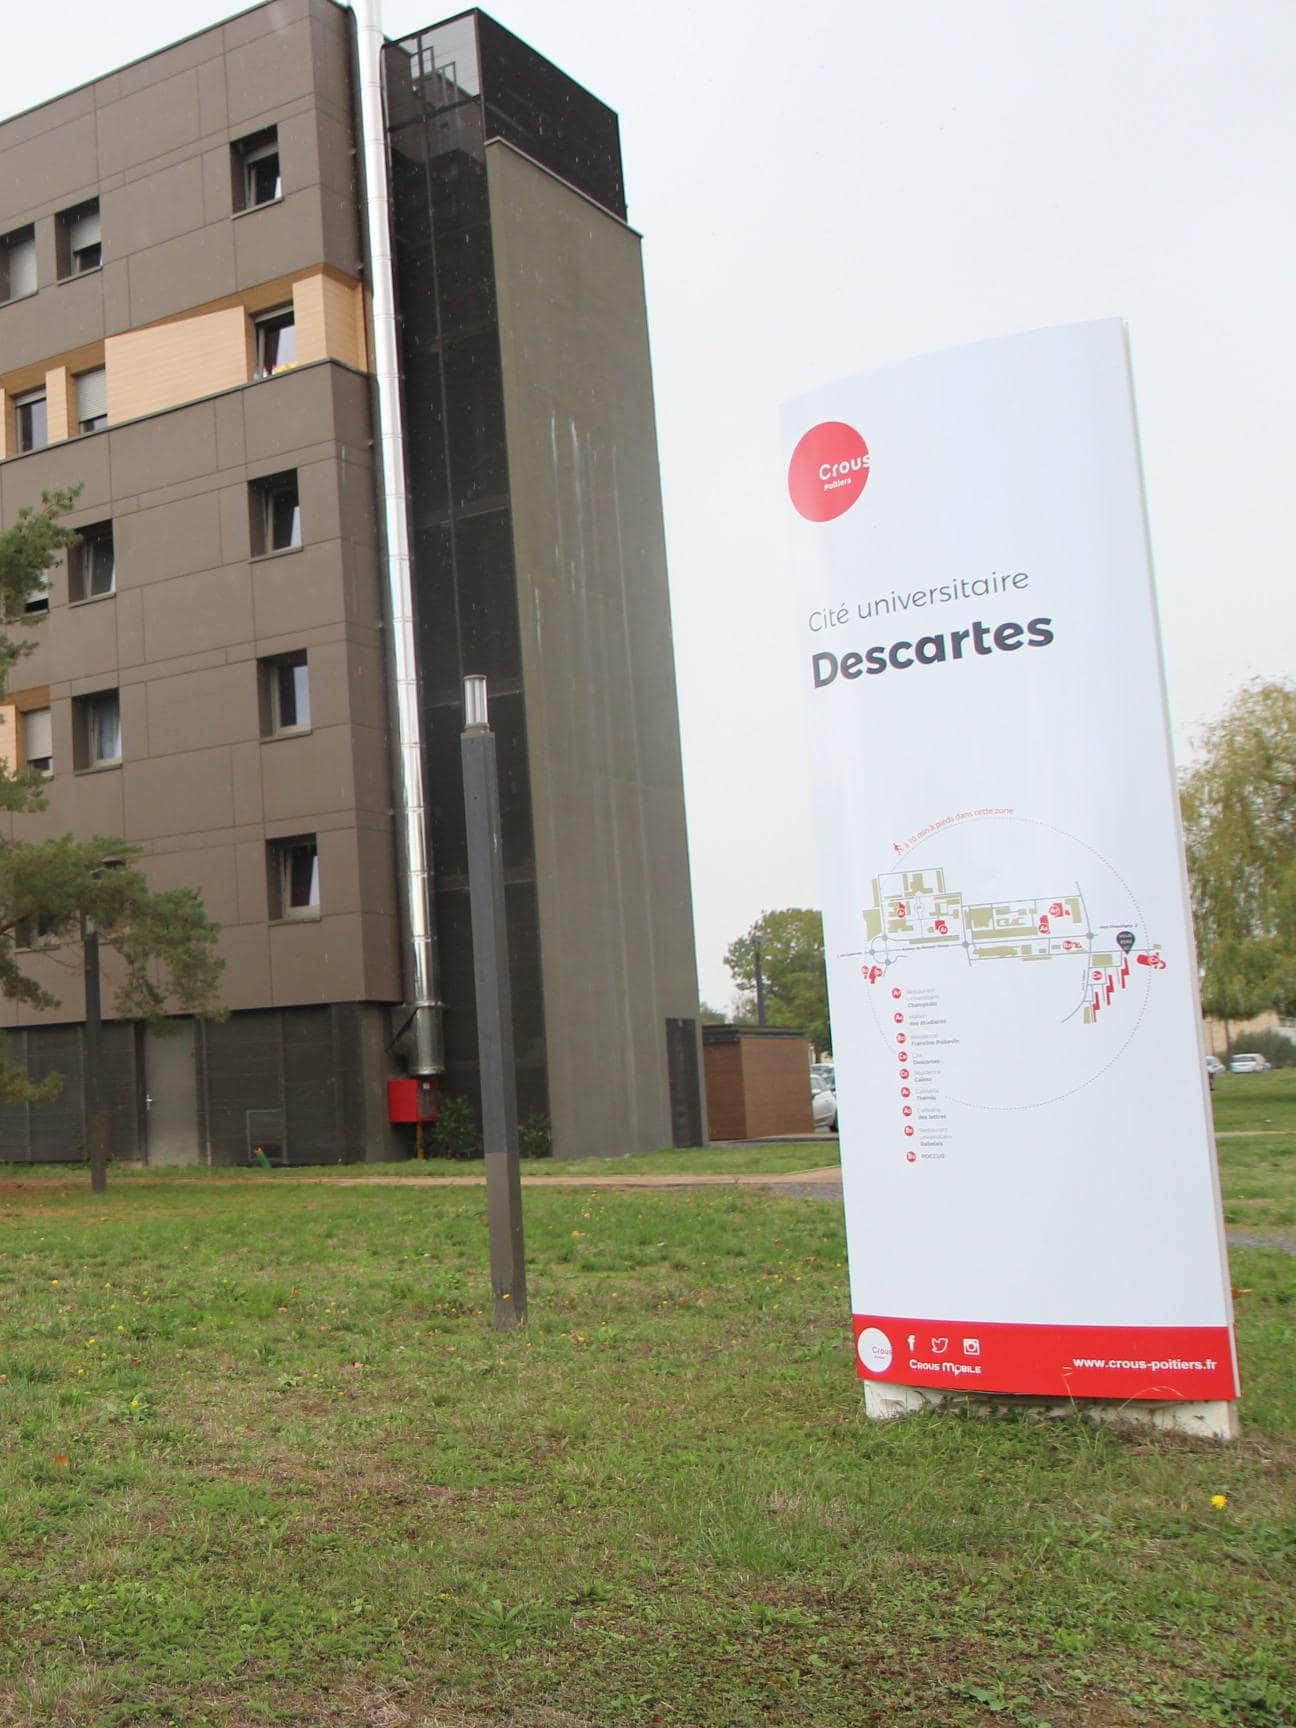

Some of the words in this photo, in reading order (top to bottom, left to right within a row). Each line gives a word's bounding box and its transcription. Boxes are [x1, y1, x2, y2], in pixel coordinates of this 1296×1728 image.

[819, 455, 871, 480] Crous
[808, 603, 849, 632] Cité
[858, 571, 1029, 619] universitaire
[812, 617, 1054, 688] Descartes
[1073, 1358, 1217, 1372] www.crous-poitiers.fr
